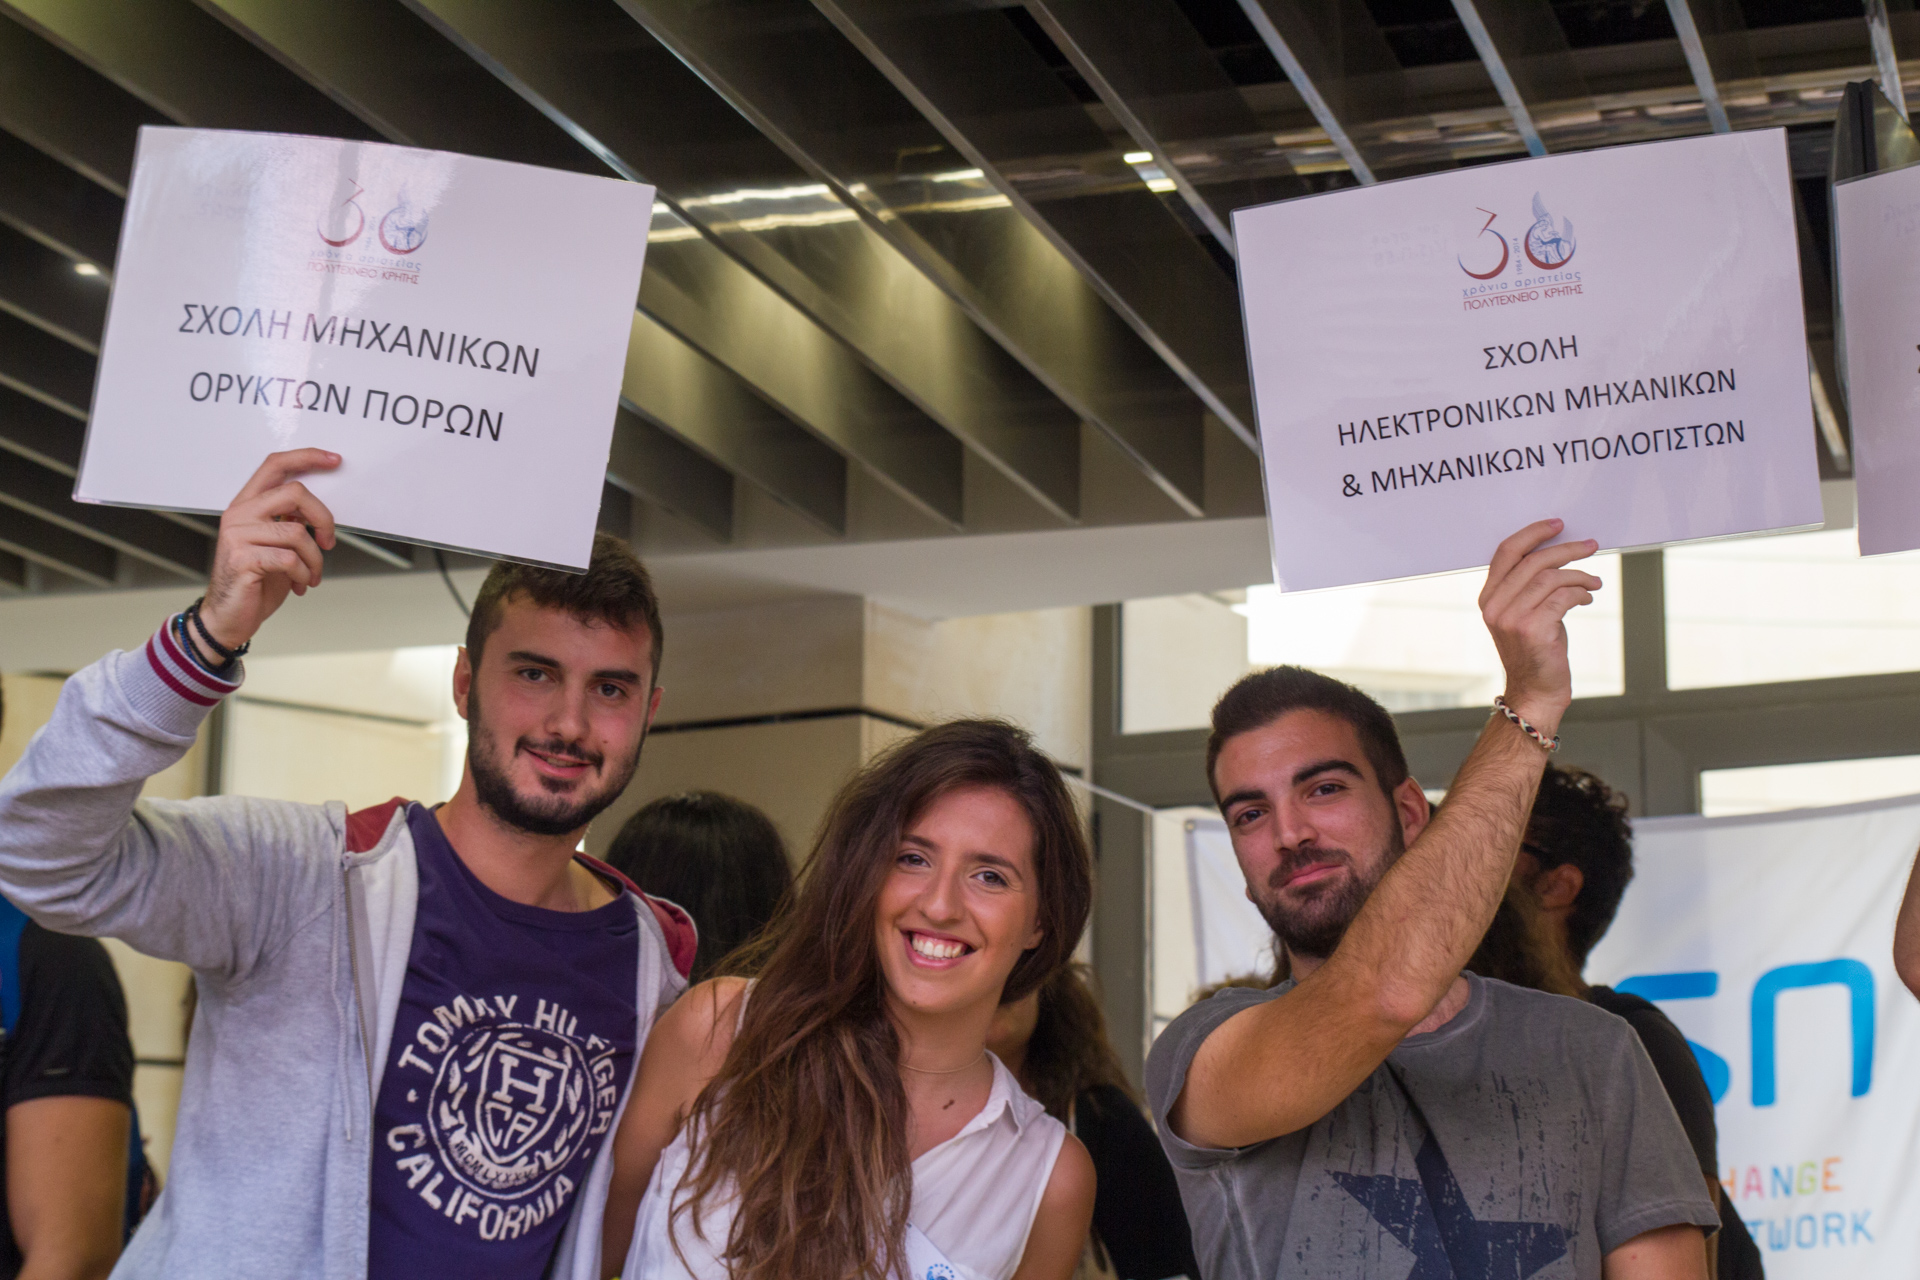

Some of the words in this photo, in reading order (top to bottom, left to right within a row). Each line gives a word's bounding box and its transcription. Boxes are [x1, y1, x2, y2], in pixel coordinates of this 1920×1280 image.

[381, 270, 420, 285] ΚΡΗΤΗΣ
[1462, 281, 1508, 298] χρόνια
[1514, 271, 1582, 288] αριστείας
[1463, 290, 1540, 311] ΠΟΛΥΤΕΧΝΕΙΟ
[1543, 284, 1583, 299] ΚΡΗΤΗΣ
[178, 303, 292, 340] ΣΧΟΛΗ
[302, 312, 540, 378] ΜΗΧΑΝΙΚΩΝ
[1482, 334, 1579, 370] ΣΧΟΛΗ
[189, 371, 351, 415] ΟΡΥΚΤΩΝ
[362, 389, 504, 442] ΠΟΡΩΝ
[1337, 390, 1556, 446] ΗΛΕΚΤΡΟΝΙΚΩΝ
[1564, 368, 1737, 412] ΜΗΧΑΝΙΚΩΝ
[1341, 473, 1364, 498] &
[1371, 445, 1546, 493] ΜΗΧΑΝΙΚΩΝ
[1552, 420, 1746, 465] ΥΠΟΛΟΓΙΣΤΩΝ
[492, 1053, 555, 1115] H
[386, 1122, 575, 1242] CALIFORNIA
